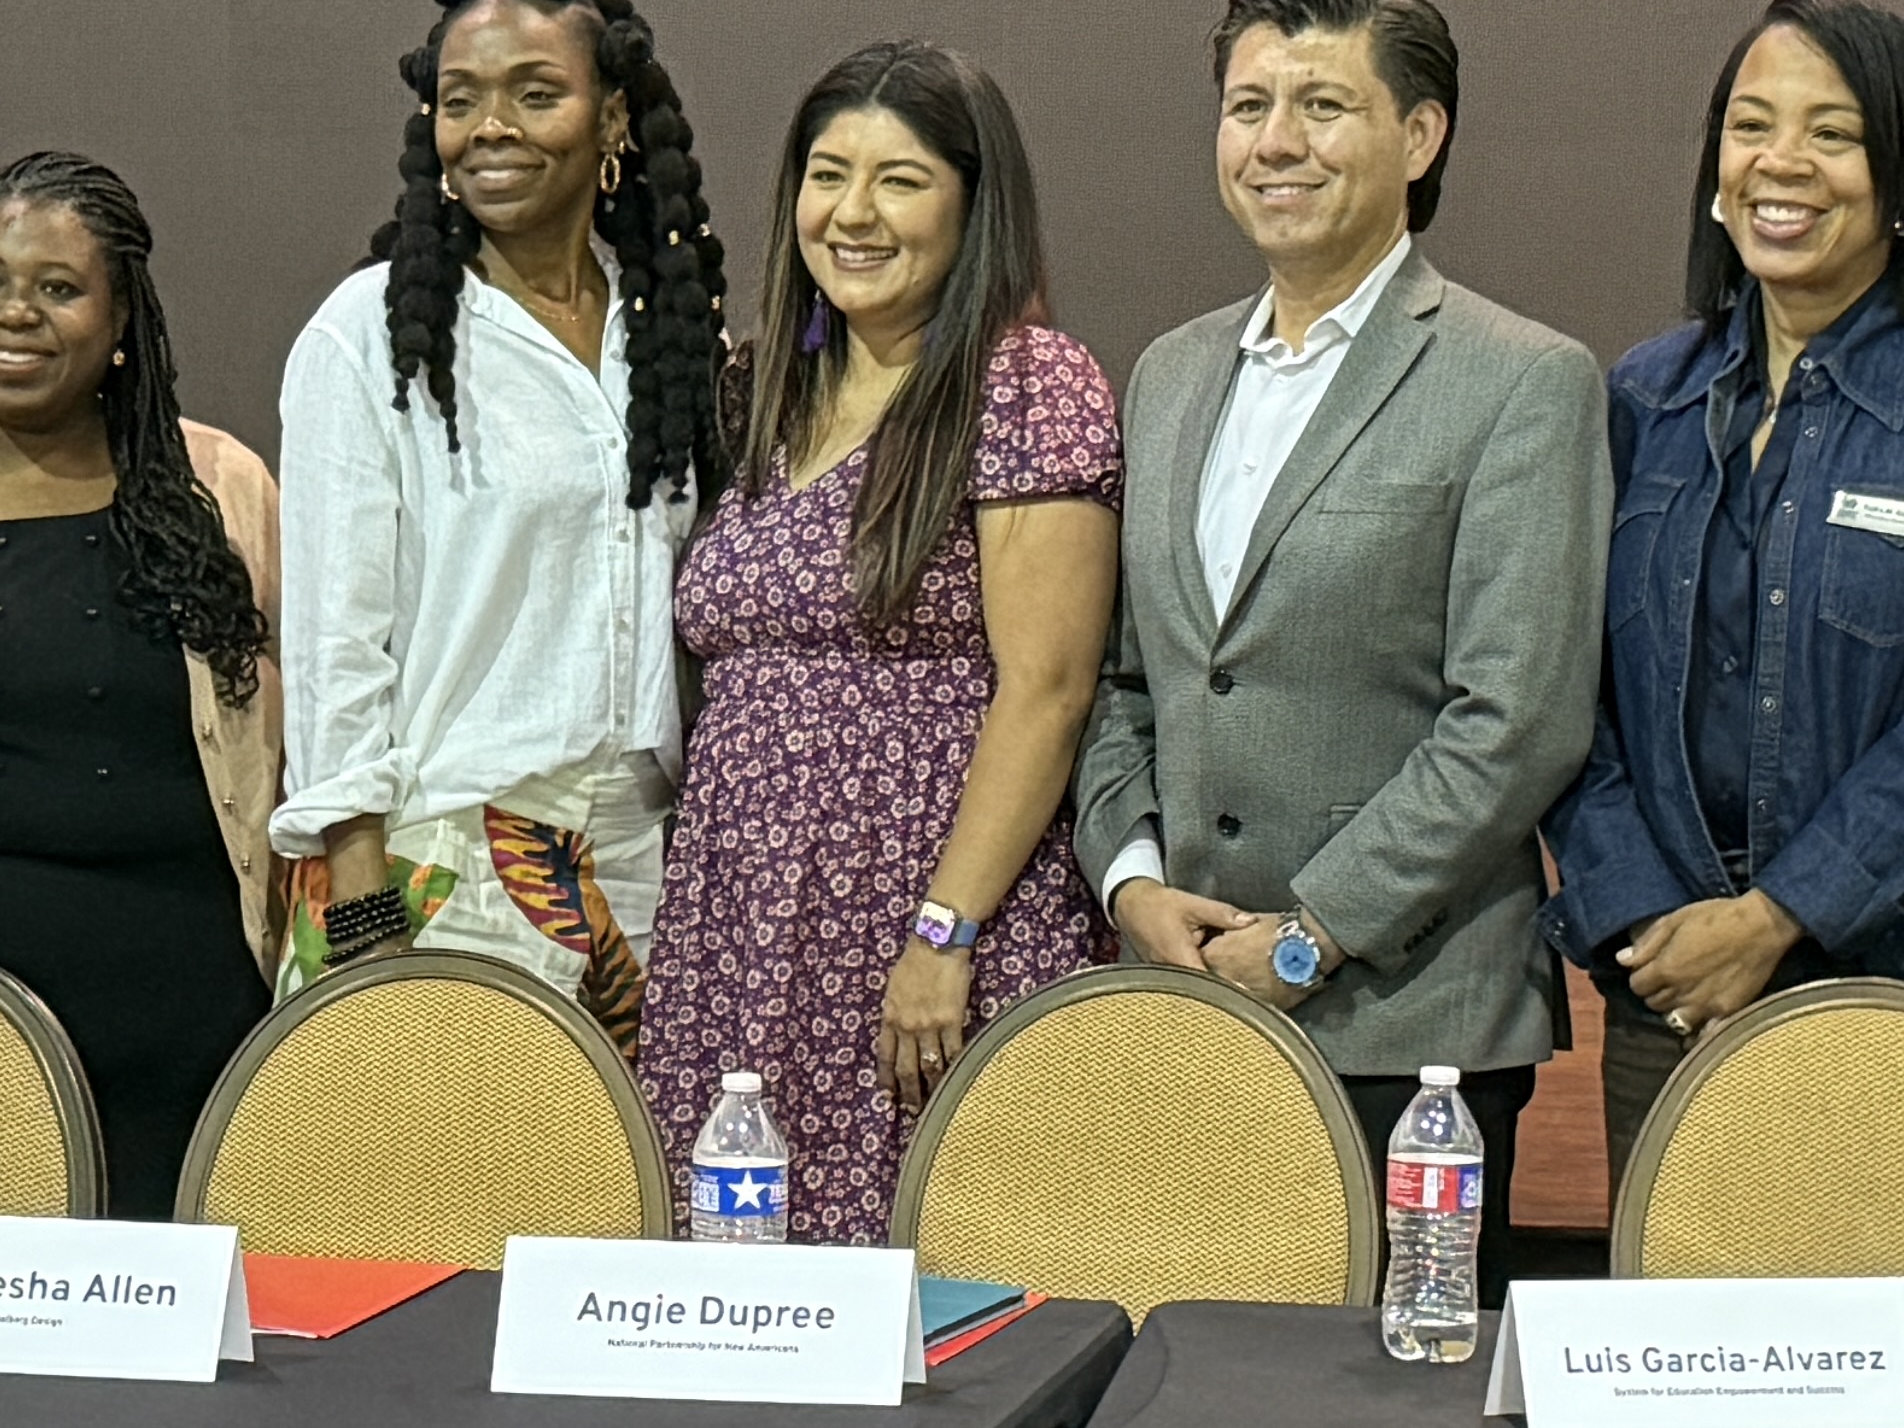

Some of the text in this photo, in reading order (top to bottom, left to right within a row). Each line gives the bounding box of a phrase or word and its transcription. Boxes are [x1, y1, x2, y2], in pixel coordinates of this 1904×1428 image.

[83, 1274, 176, 1306] Allen
[576, 1292, 836, 1334] Angie Dupree
[1564, 1346, 1886, 1373] Luis Garcia-Alvarez
